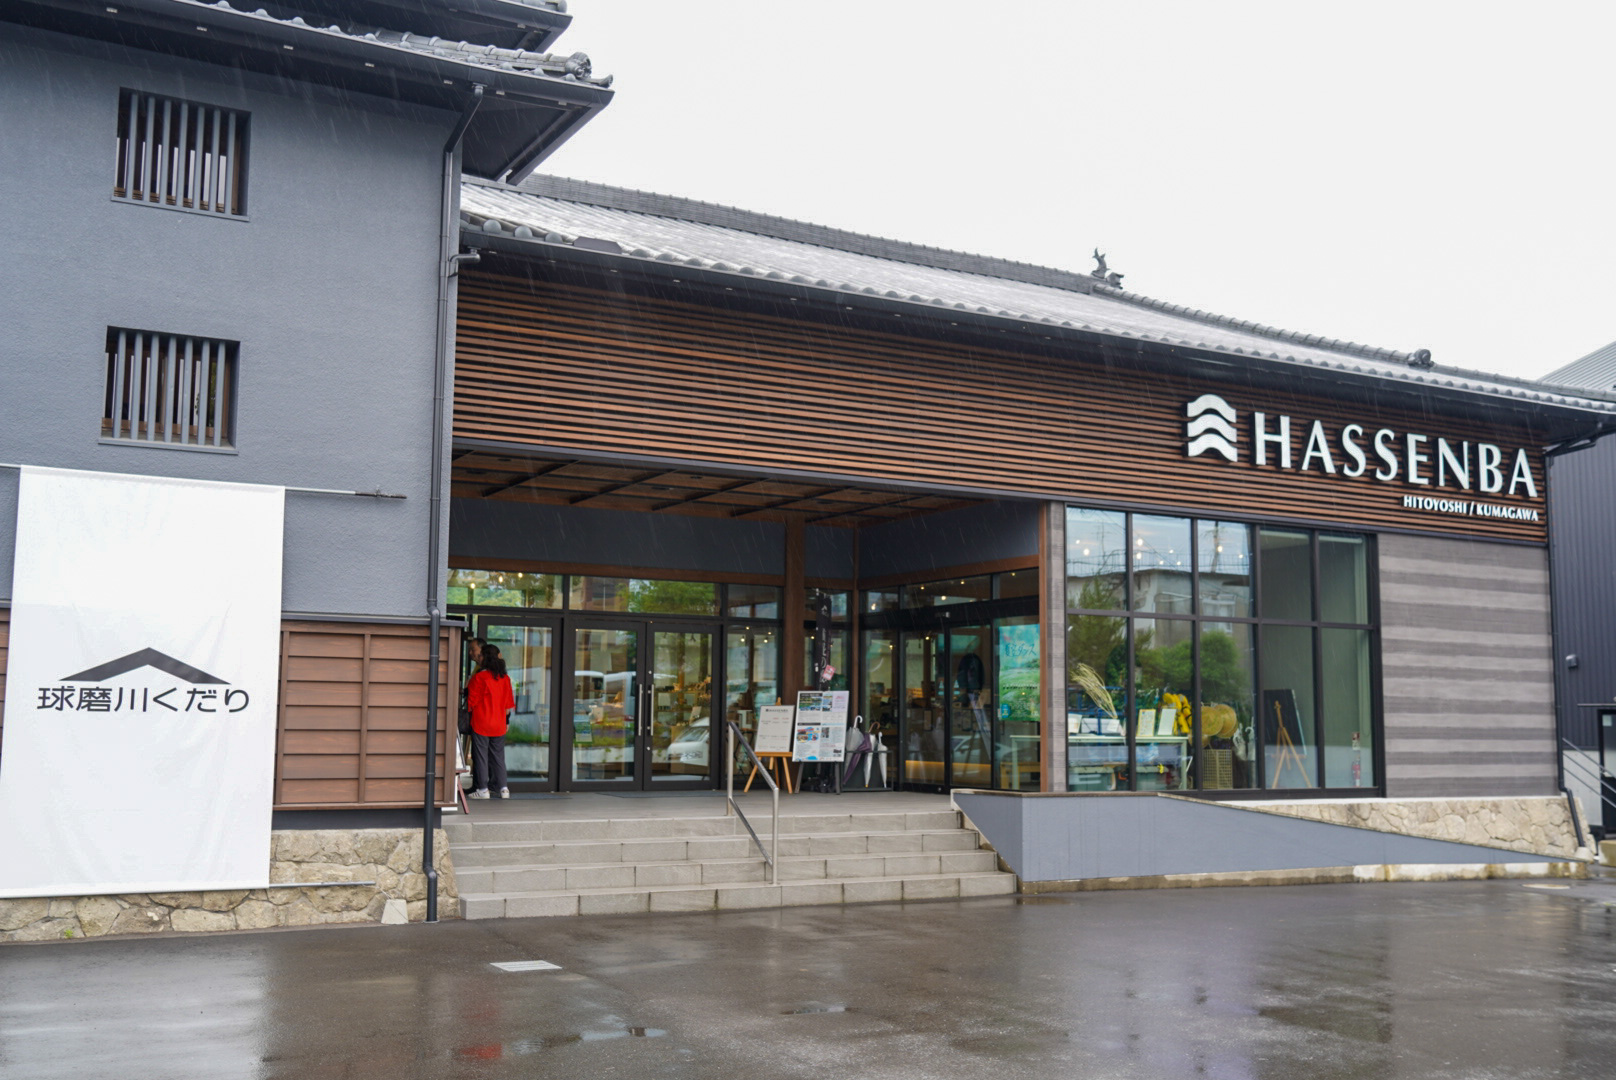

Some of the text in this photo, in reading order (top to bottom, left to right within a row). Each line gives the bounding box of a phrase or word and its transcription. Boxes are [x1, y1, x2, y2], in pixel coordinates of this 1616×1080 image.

[1253, 411, 1538, 498] HASSENBA
[1403, 495, 1467, 514] HITOYOSHI
[1476, 503, 1539, 522] KUMAGAWA
[36, 686, 250, 713] 球磨川くだり
